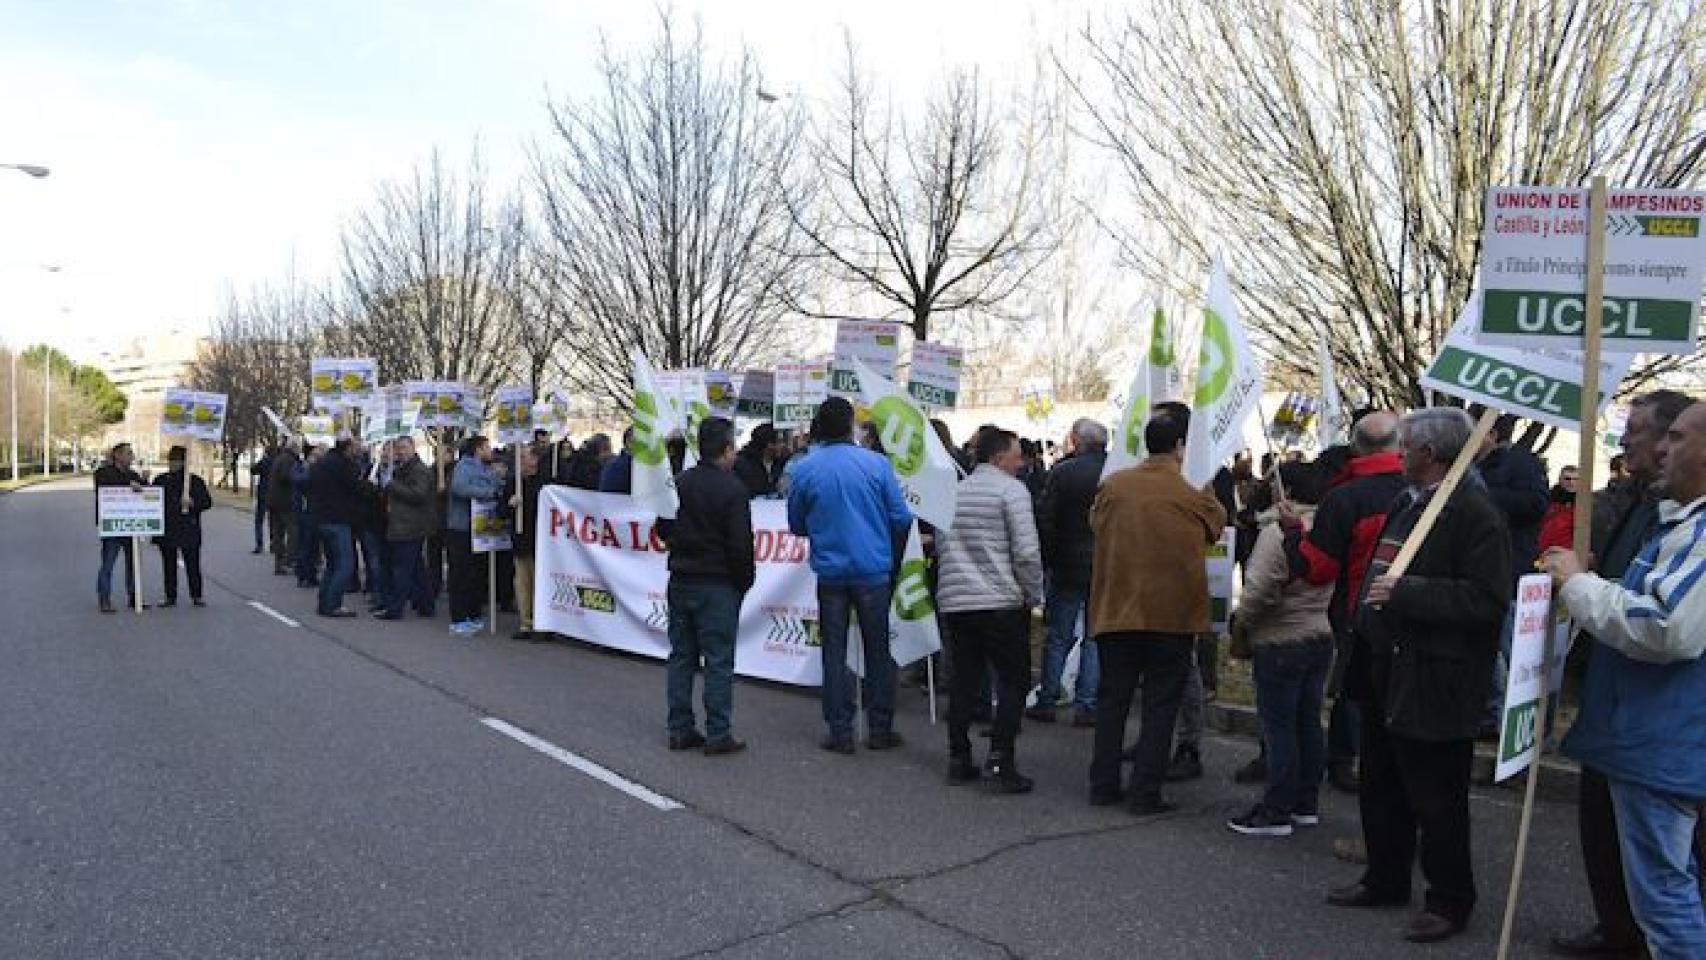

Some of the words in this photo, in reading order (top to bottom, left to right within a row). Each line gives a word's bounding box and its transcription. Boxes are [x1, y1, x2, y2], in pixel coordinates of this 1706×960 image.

[1496, 193, 1552, 209] UNION
[1558, 193, 1580, 209] DE
[1587, 194, 1704, 212] MPESINOS
[1495, 215, 1539, 233] Castilla
[1649, 219, 1691, 234] UCCL
[1544, 257, 1588, 280] Princip
[1516, 295, 1653, 337] UCCL
[1457, 356, 1564, 413] UCCL
[549, 508, 622, 549] PAGA
